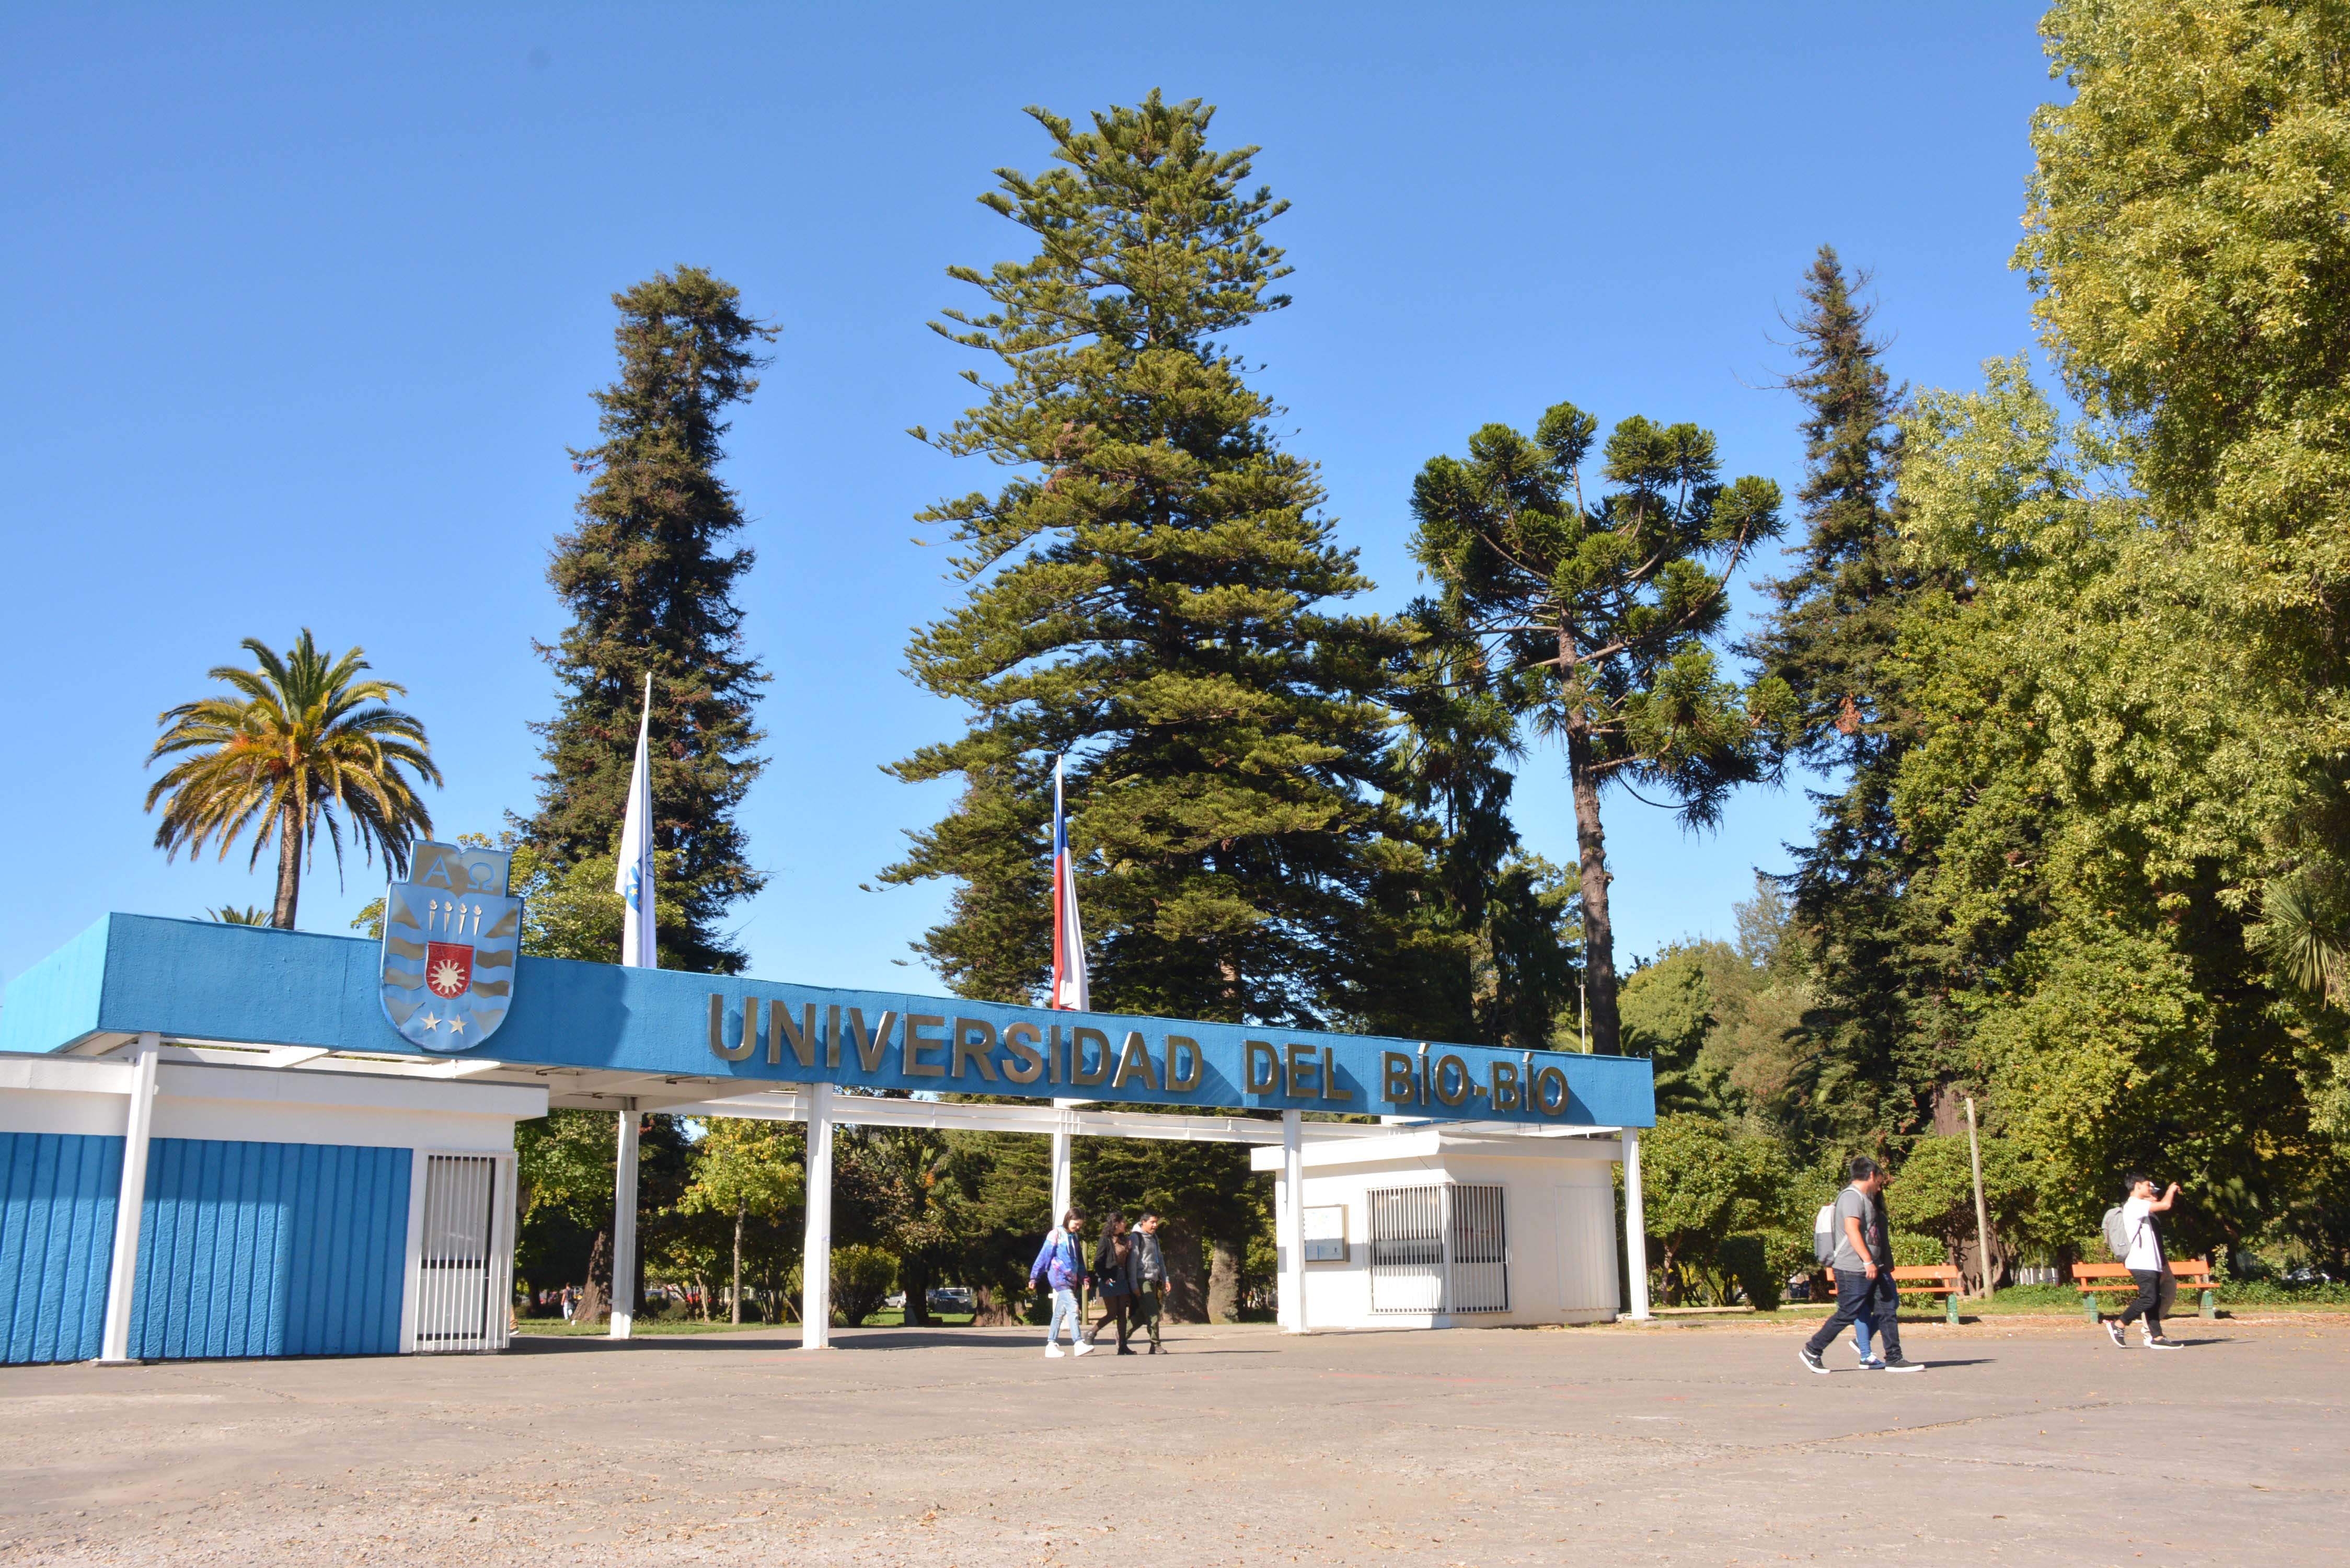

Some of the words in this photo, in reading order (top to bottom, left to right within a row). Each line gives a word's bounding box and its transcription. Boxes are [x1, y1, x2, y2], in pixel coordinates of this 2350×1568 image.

[708, 993, 1203, 1091] UNIVERSIDAD
[1243, 1040, 1353, 1100] DEL
[1380, 1042, 1569, 1115] BÍO-BÍO
